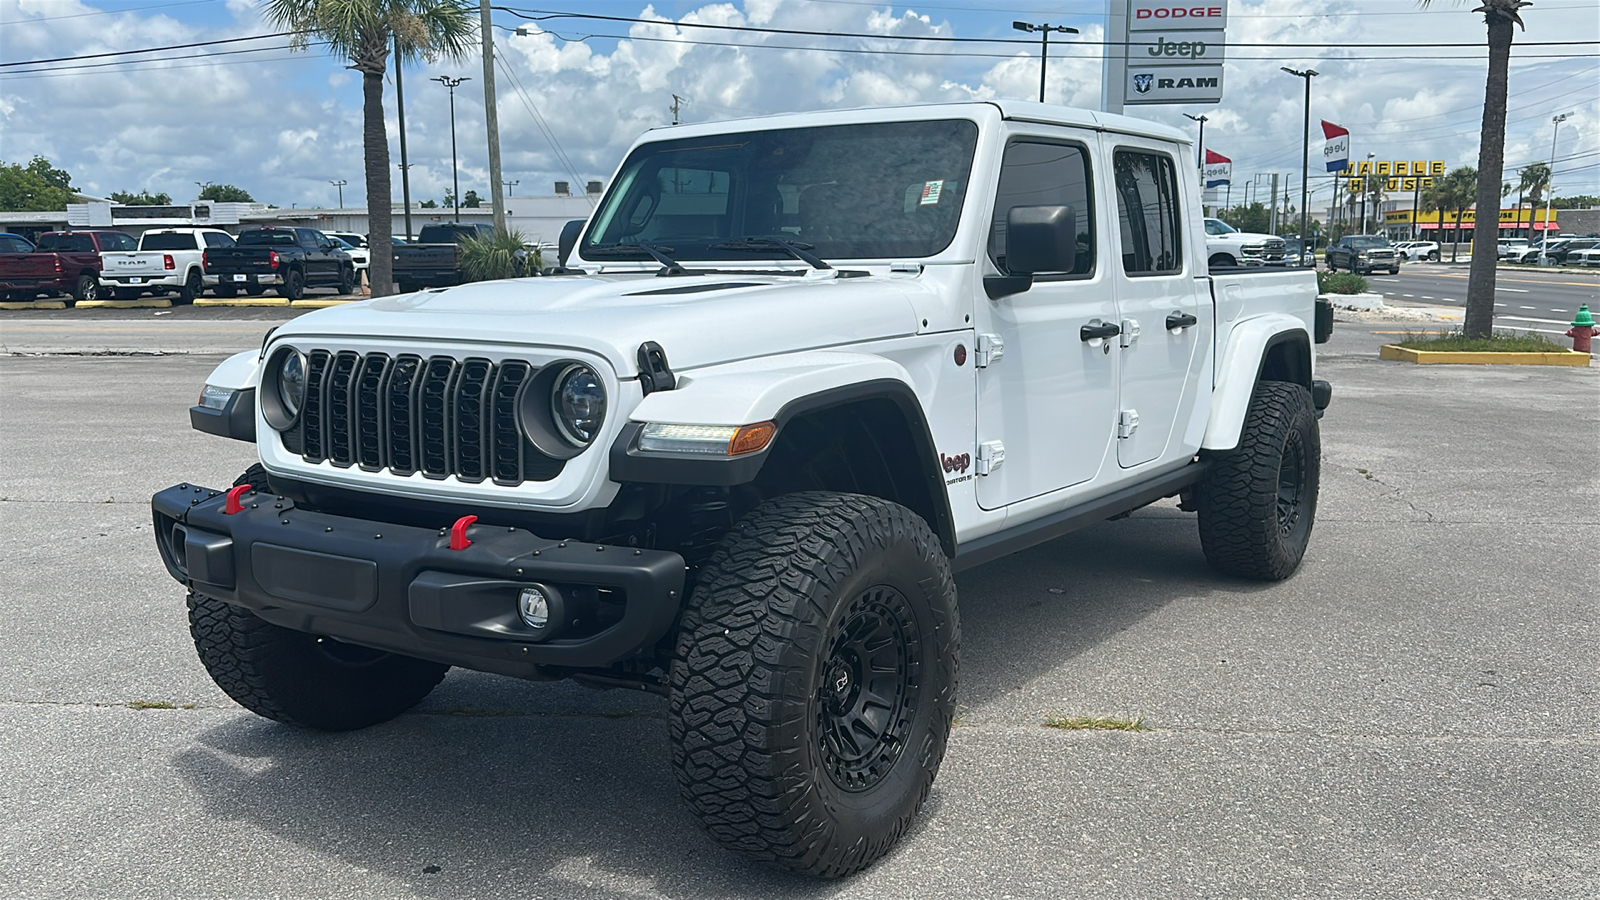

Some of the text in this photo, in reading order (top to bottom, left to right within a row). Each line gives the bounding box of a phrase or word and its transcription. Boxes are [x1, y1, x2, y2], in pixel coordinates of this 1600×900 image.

[1136, 7, 1222, 19] DODGE
[1148, 37, 1206, 60] Jeep
[1157, 77, 1218, 88] RAM
[1343, 163, 1443, 174] WAFFLE
[1351, 179, 1434, 190] HUSE
